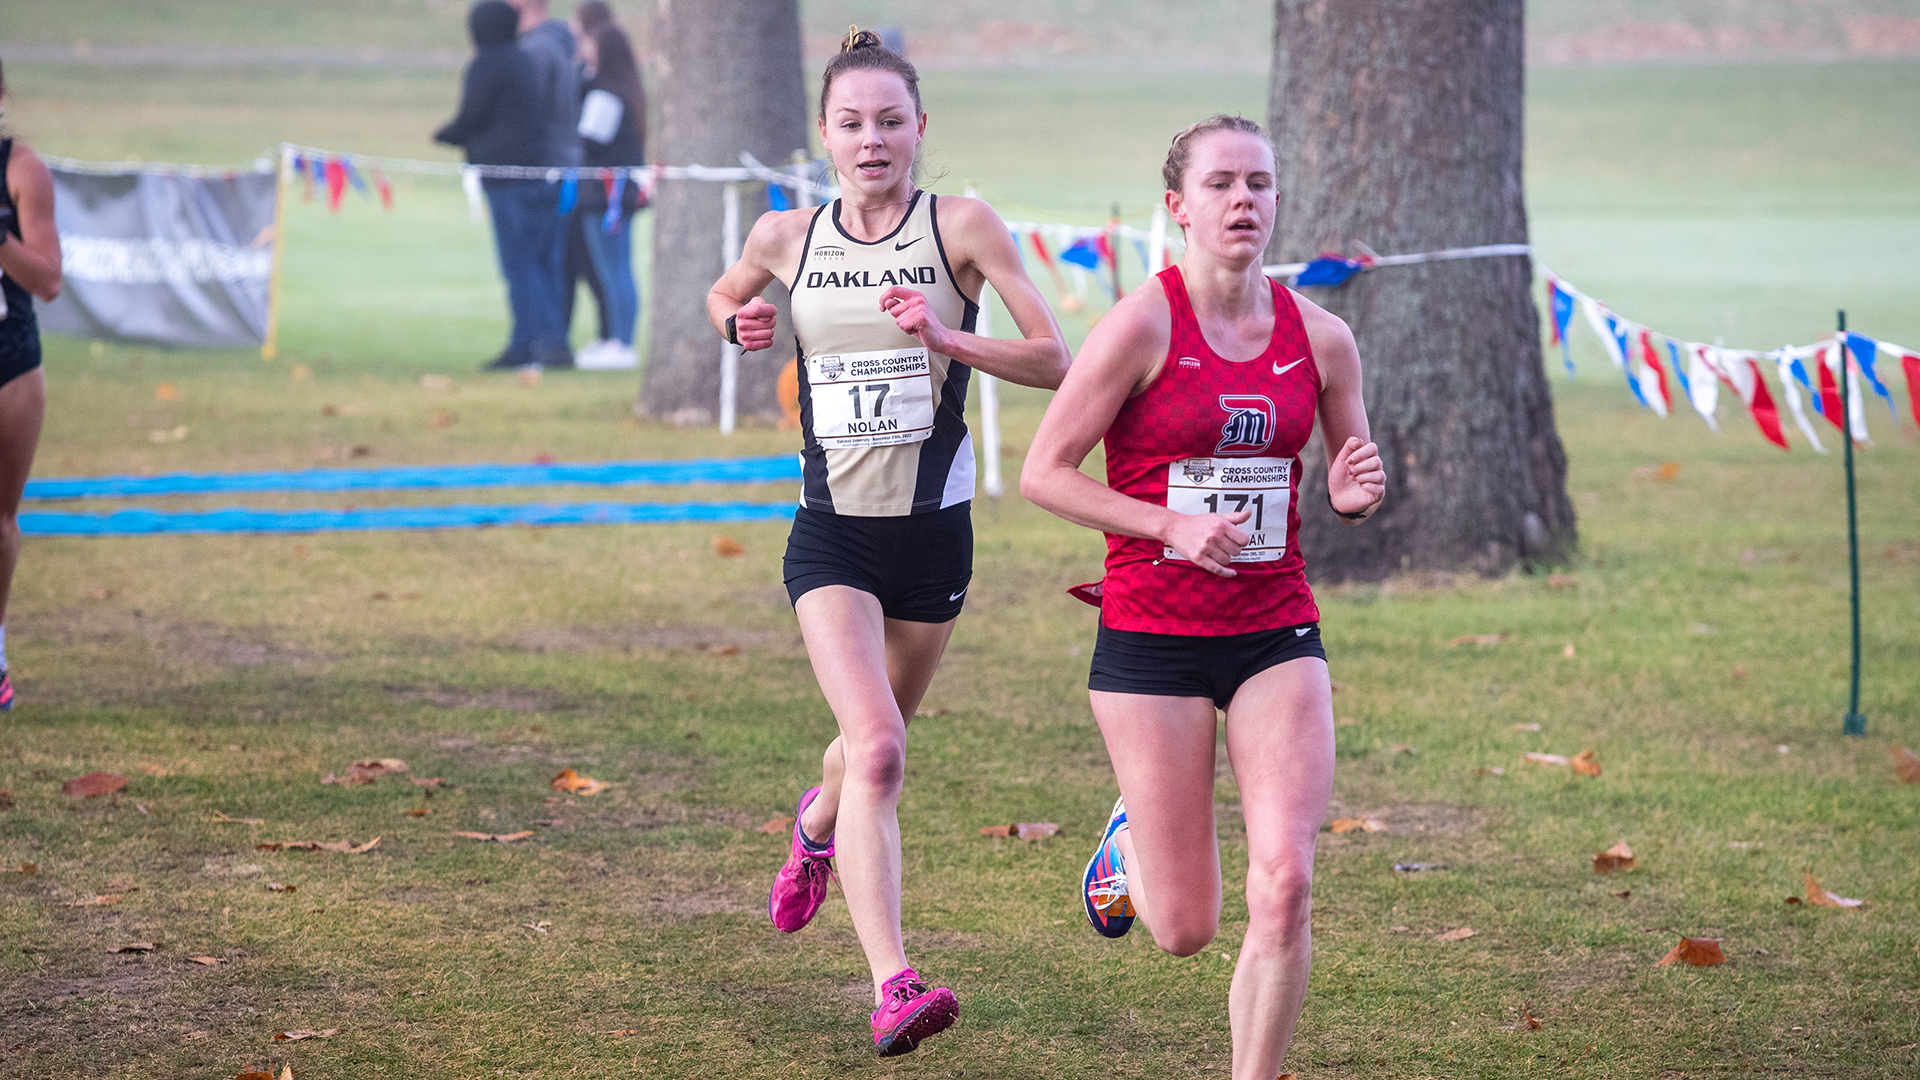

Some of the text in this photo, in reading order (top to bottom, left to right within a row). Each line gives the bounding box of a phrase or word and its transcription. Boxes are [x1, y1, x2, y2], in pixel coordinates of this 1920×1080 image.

[806, 266, 937, 289] OAKLAND
[851, 360, 880, 368] CROSS
[882, 355, 925, 366] COUNTRY
[850, 363, 927, 376] CHAMPIONSHIPS
[848, 384, 890, 419] 17
[847, 419, 898, 434] NOLAN
[1223, 467, 1252, 475] CROSS
[1253, 466, 1288, 474] COUNTRY
[1220, 474, 1288, 484] CHAMPIONSHIPS
